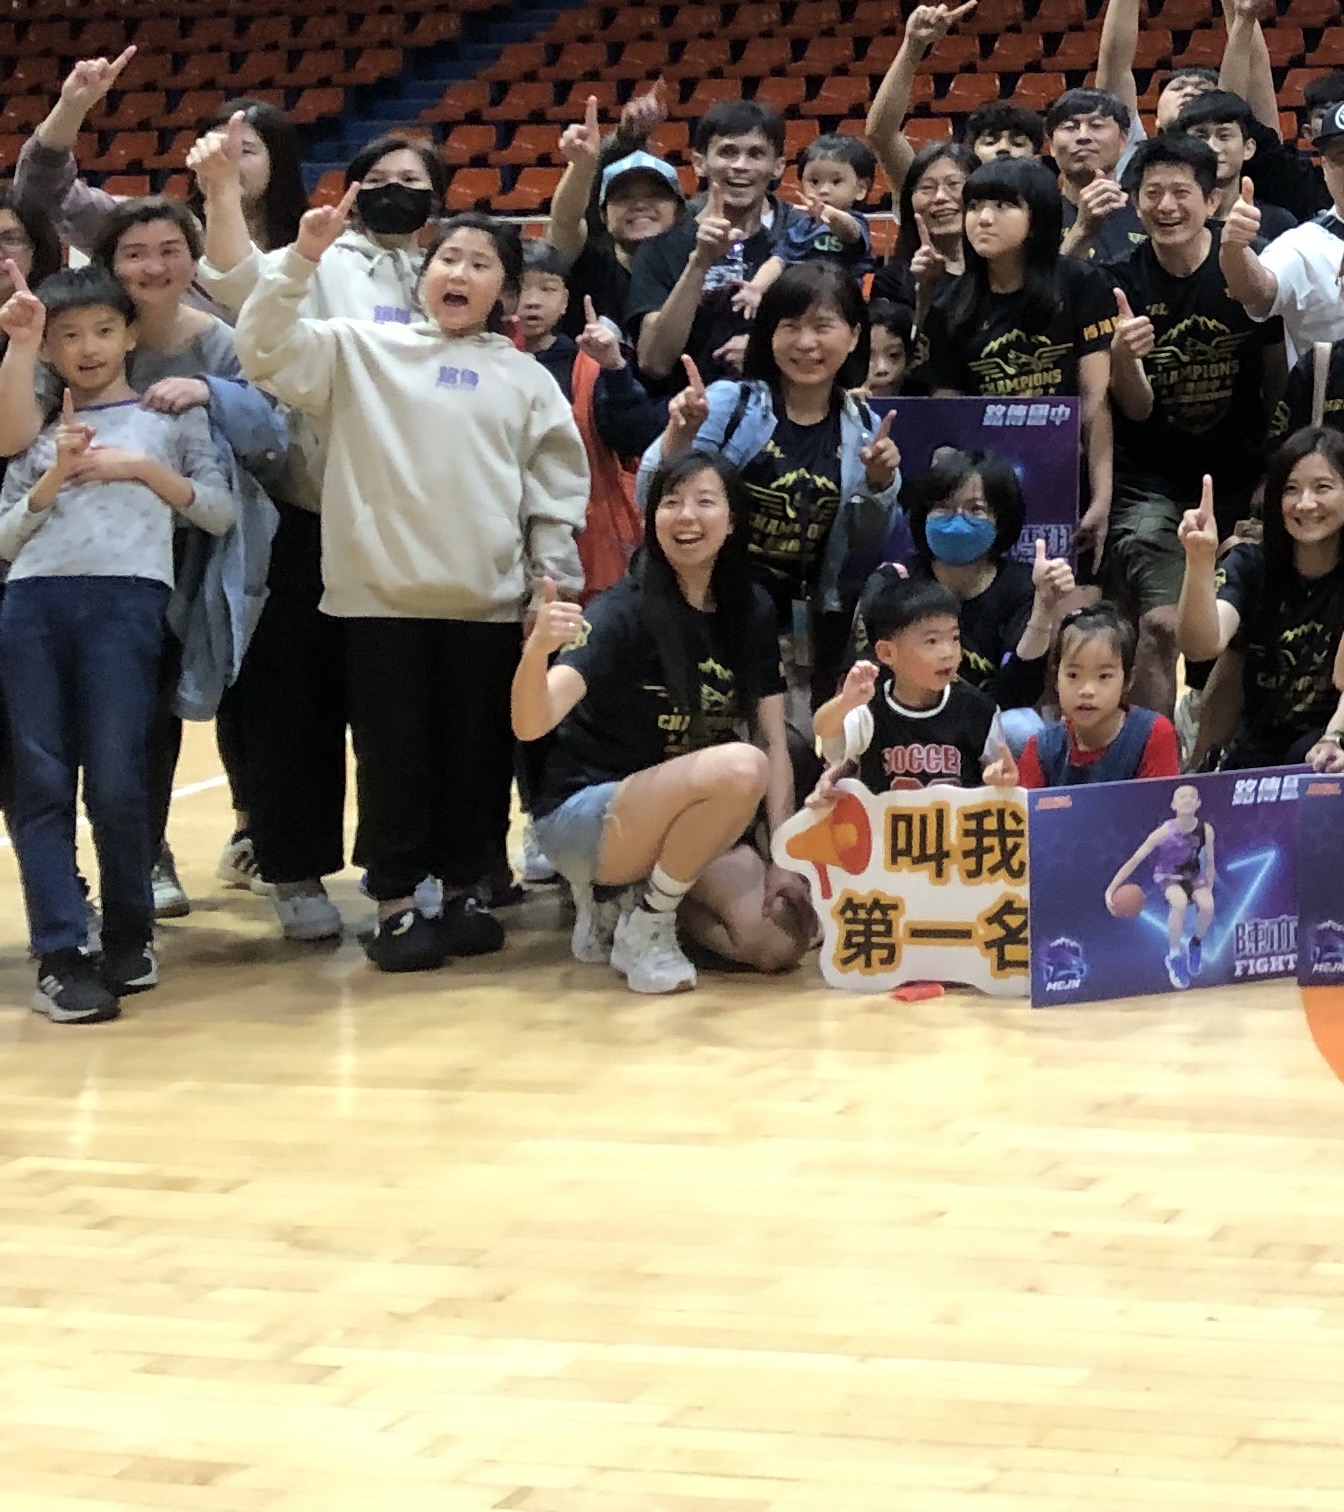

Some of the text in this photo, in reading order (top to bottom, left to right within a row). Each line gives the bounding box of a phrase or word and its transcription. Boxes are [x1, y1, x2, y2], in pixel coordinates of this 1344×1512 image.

[1232, 775, 1299, 806] 銘傳國
[889, 807, 1028, 880] 叫我
[837, 896, 1029, 972] 第一名
[1234, 953, 1298, 978] FIGHT
